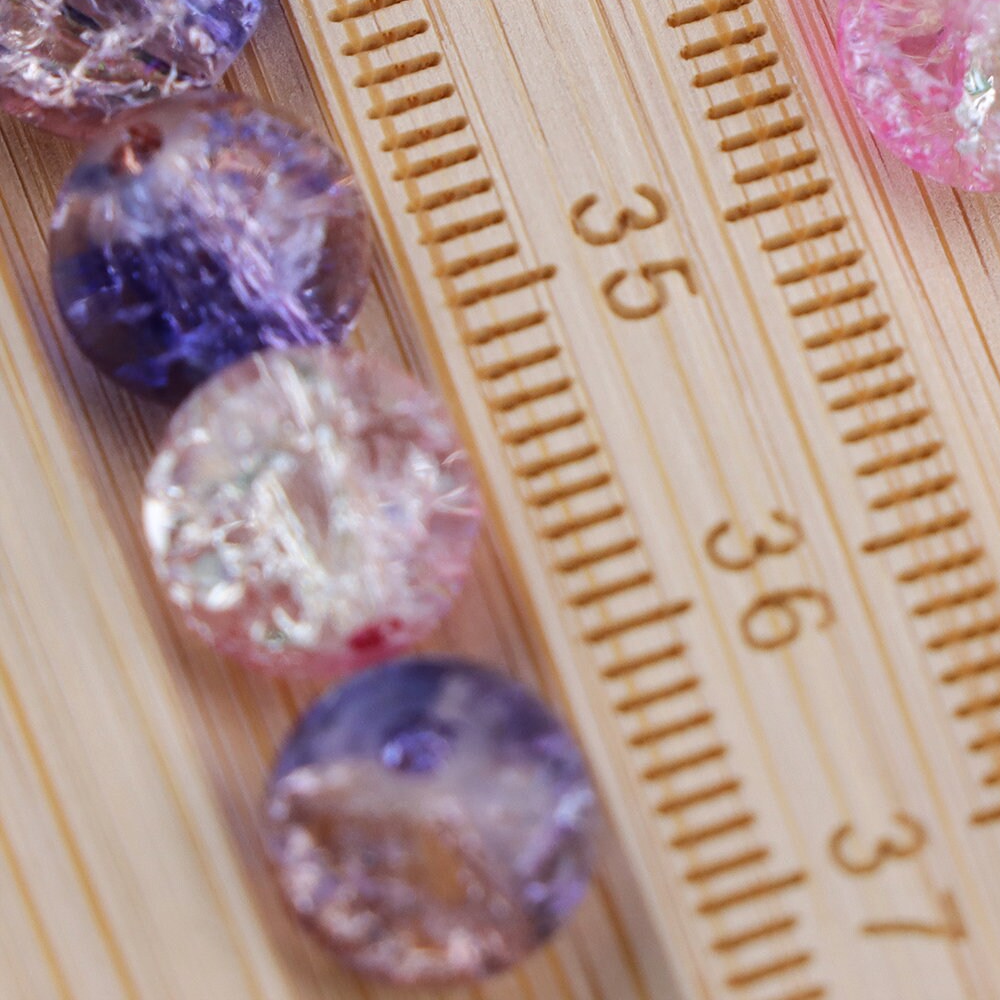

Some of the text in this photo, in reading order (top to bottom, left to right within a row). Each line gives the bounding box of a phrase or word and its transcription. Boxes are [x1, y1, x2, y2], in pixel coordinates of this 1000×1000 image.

[570, 184, 699, 322] 35
[704, 508, 838, 652] 36
[829, 808, 969, 944] 37
